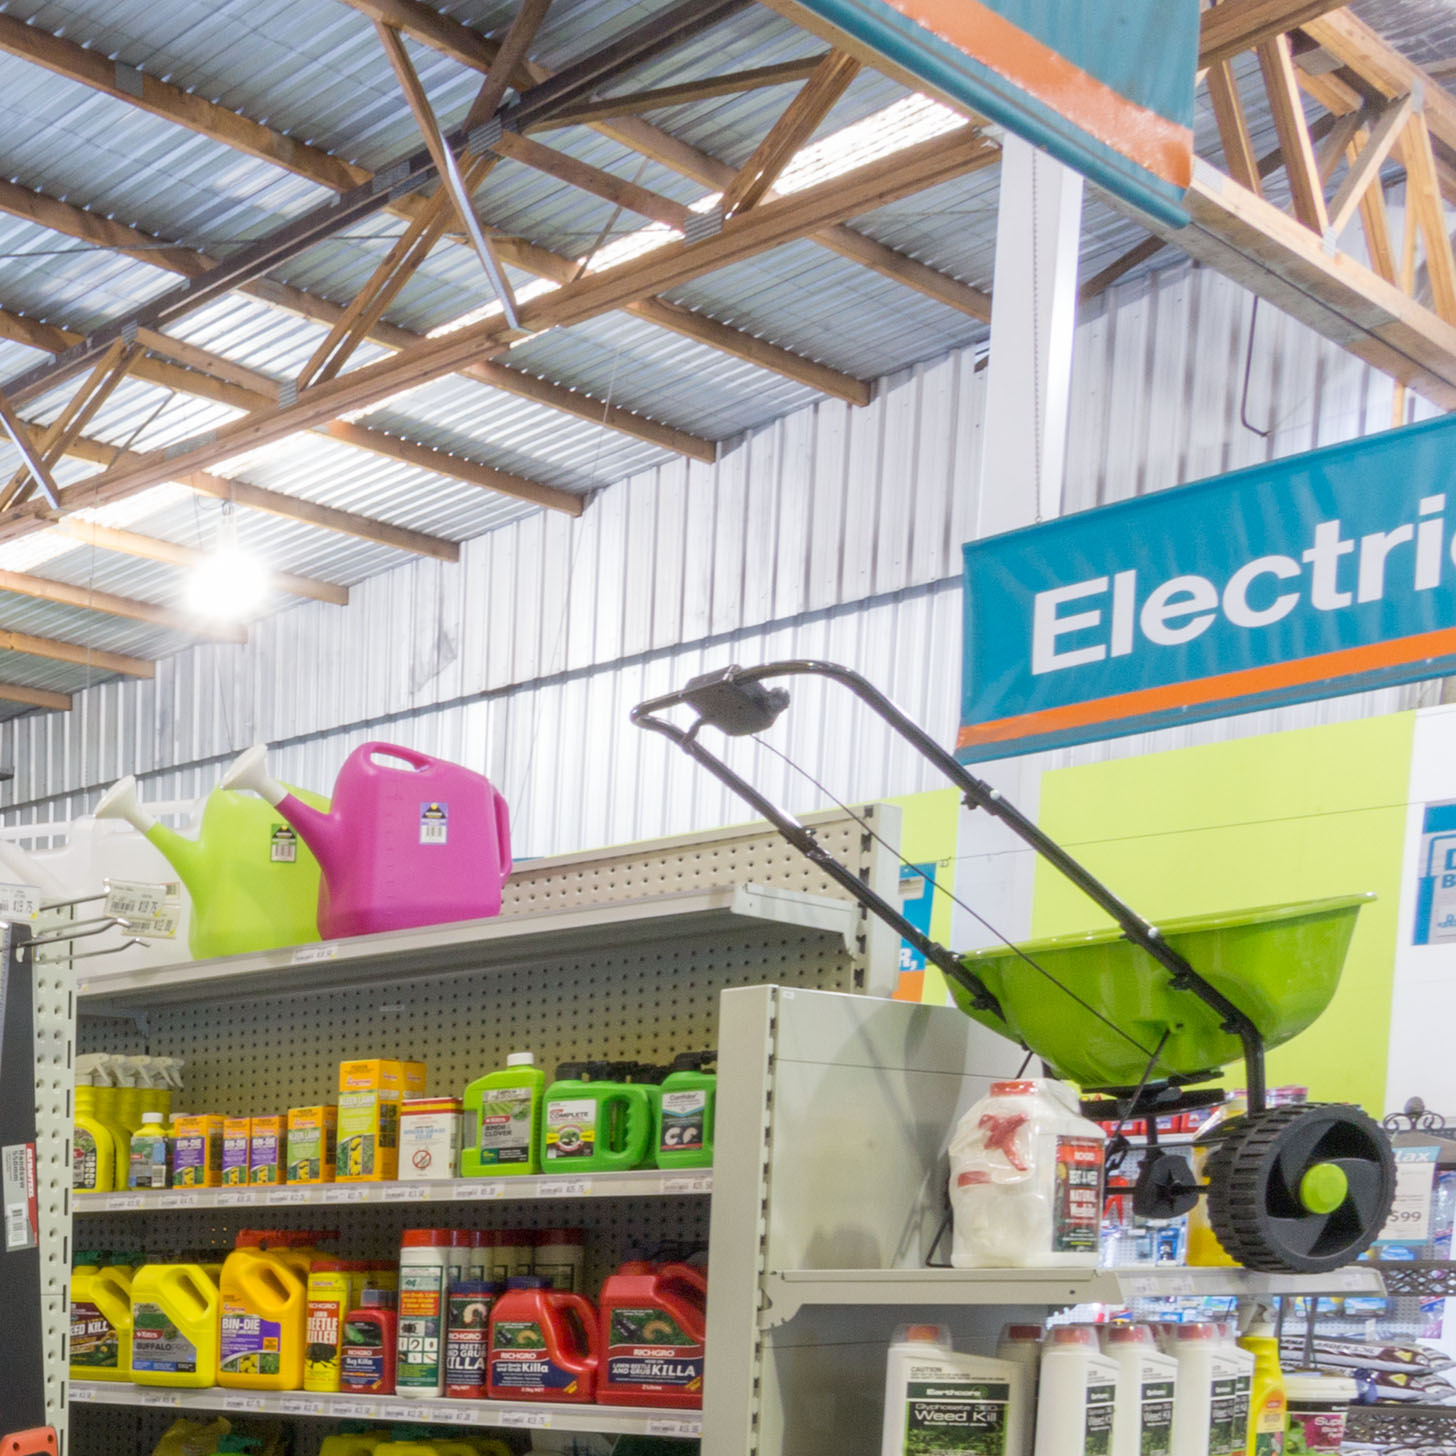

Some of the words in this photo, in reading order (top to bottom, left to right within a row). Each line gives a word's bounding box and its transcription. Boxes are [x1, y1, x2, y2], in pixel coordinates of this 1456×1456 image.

[1031, 493, 1456, 676] Electri
[550, 1111, 588, 1120] COMPLETE
[88, 1319, 109, 1333] KILL
[222, 1317, 261, 1331] BIN-DIE
[633, 1349, 675, 1357] RICHGRO
[522, 1361, 549, 1374] Killa
[651, 1364, 696, 1377] KILLA
[926, 1388, 982, 1397] Earthcore
[915, 1403, 971, 1412] Glyphosate
[915, 1411, 967, 1422] Weed
[973, 1411, 997, 1422] Kill
